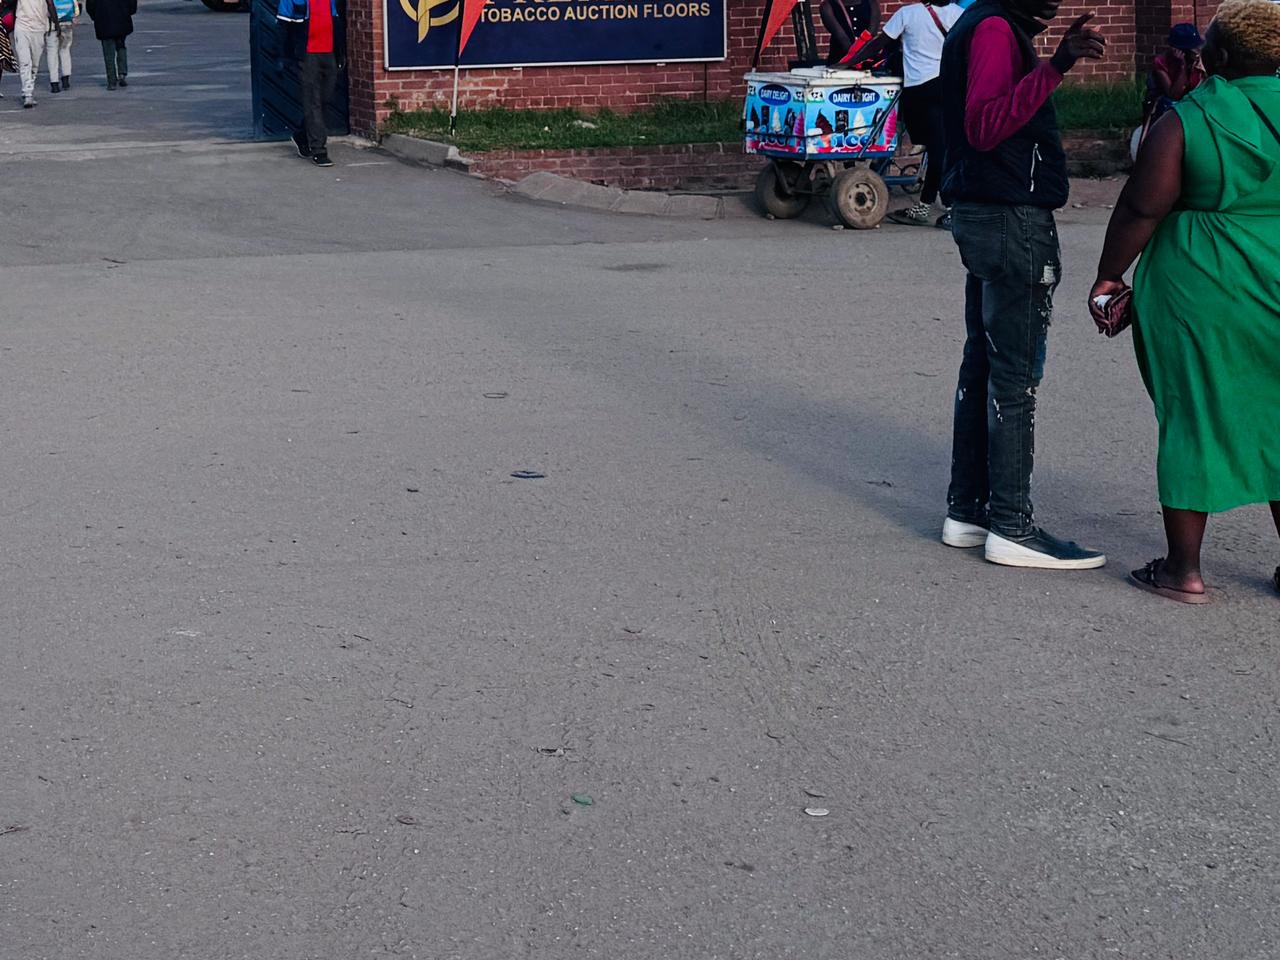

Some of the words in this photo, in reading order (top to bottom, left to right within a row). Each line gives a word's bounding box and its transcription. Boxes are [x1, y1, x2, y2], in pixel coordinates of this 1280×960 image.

[564, 4, 638, 21] AUCTION
[643, 2, 711, 18] FLOORS
[832, 92, 851, 103] DAIRY
